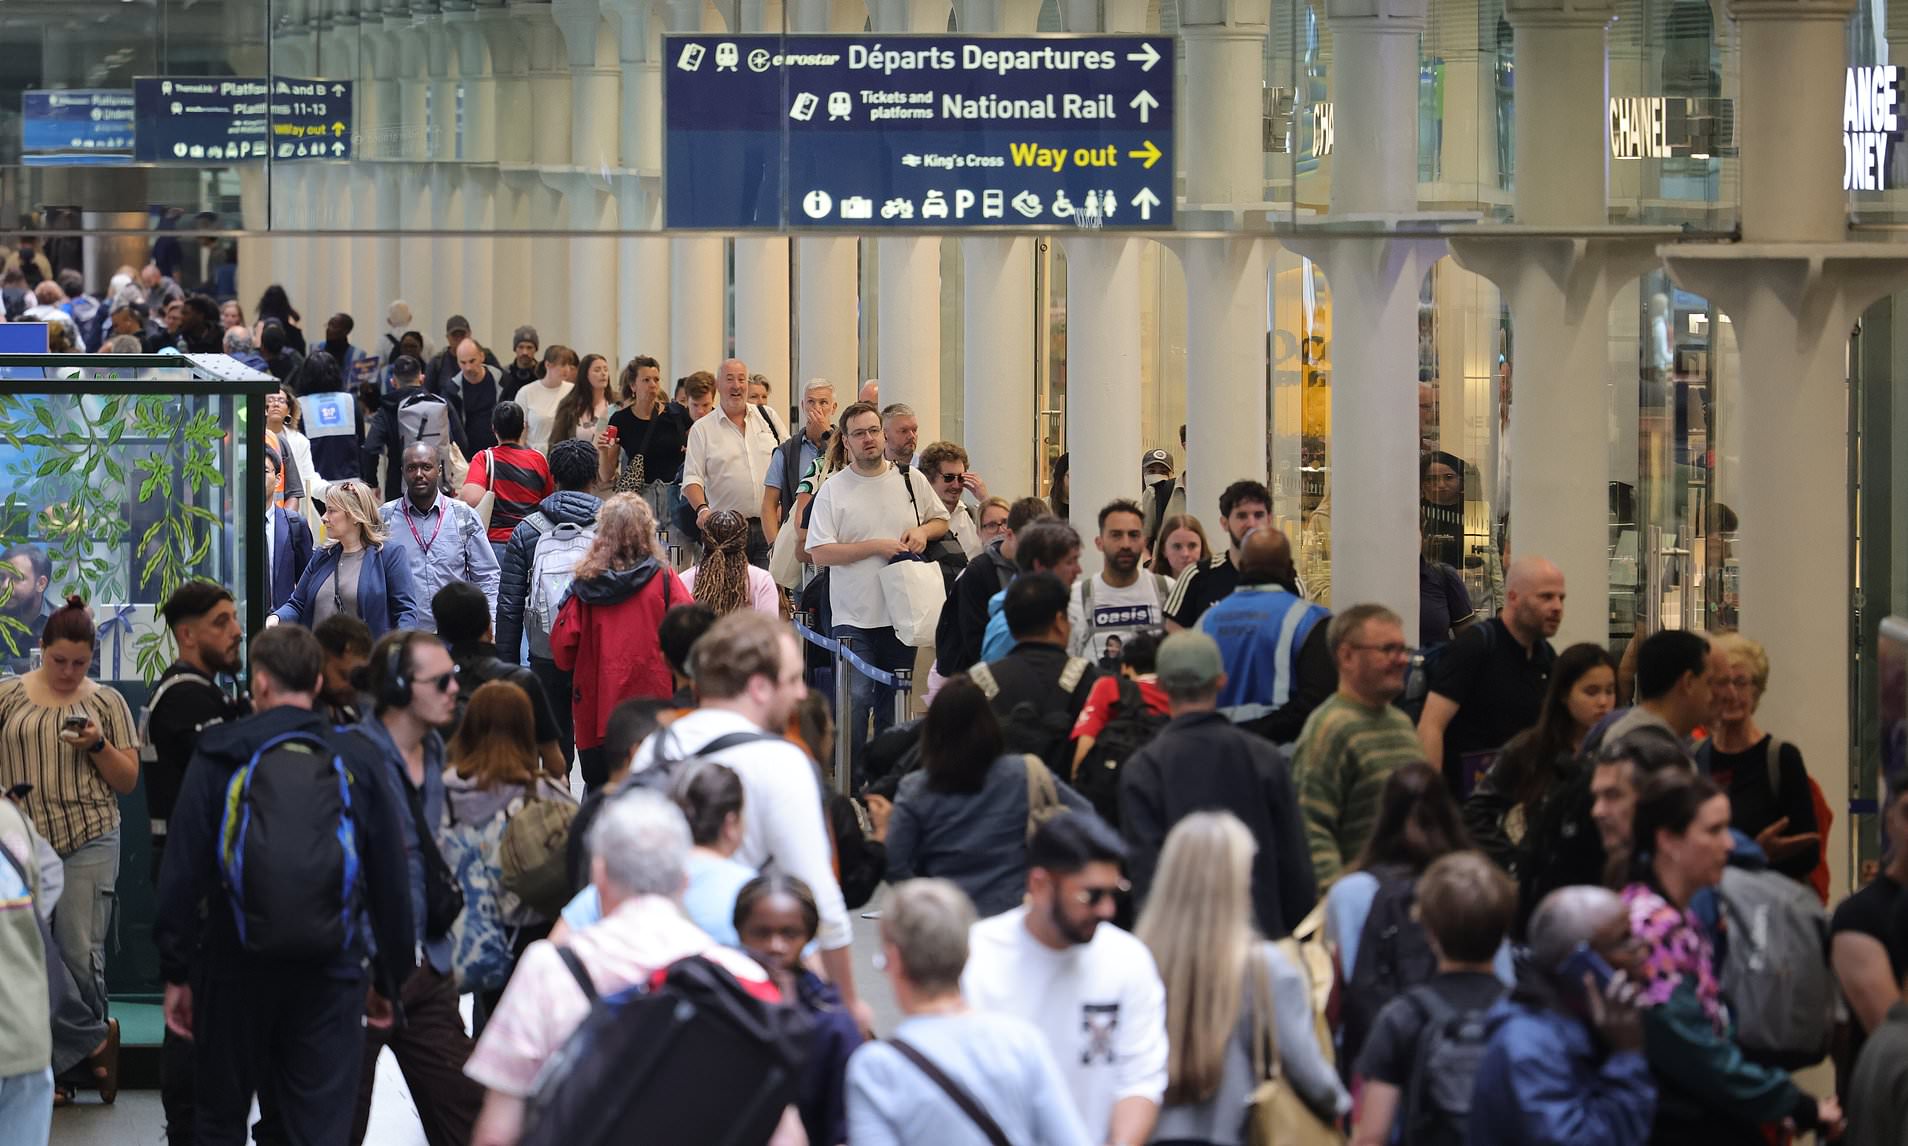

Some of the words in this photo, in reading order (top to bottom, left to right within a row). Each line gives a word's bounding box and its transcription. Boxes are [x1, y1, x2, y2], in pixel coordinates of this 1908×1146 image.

[772, 53, 840, 66] eurostar
[849, 44, 956, 75] Départs
[963, 45, 1116, 75] Departures
[292, 85, 314, 95] and
[316, 85, 326, 95] B
[860, 91, 907, 104] Tickets
[908, 91, 934, 104] and
[1844, 65, 1896, 132] ANGE
[294, 103, 326, 115] 11-13
[870, 106, 934, 121] platforms
[942, 94, 1057, 119] National
[1063, 94, 1116, 119] Rail
[307, 124, 326, 136] out
[1313, 103, 1334, 157] CHA
[1610, 97, 1671, 157] CHANEL
[923, 153, 965, 170] King's
[965, 154, 1005, 167] Cross
[1010, 143, 1068, 172] Way
[1073, 145, 1117, 166] out
[1843, 132, 1887, 191] ONEY
[955, 189, 975, 218] P
[1097, 607, 1147, 625] oasis
